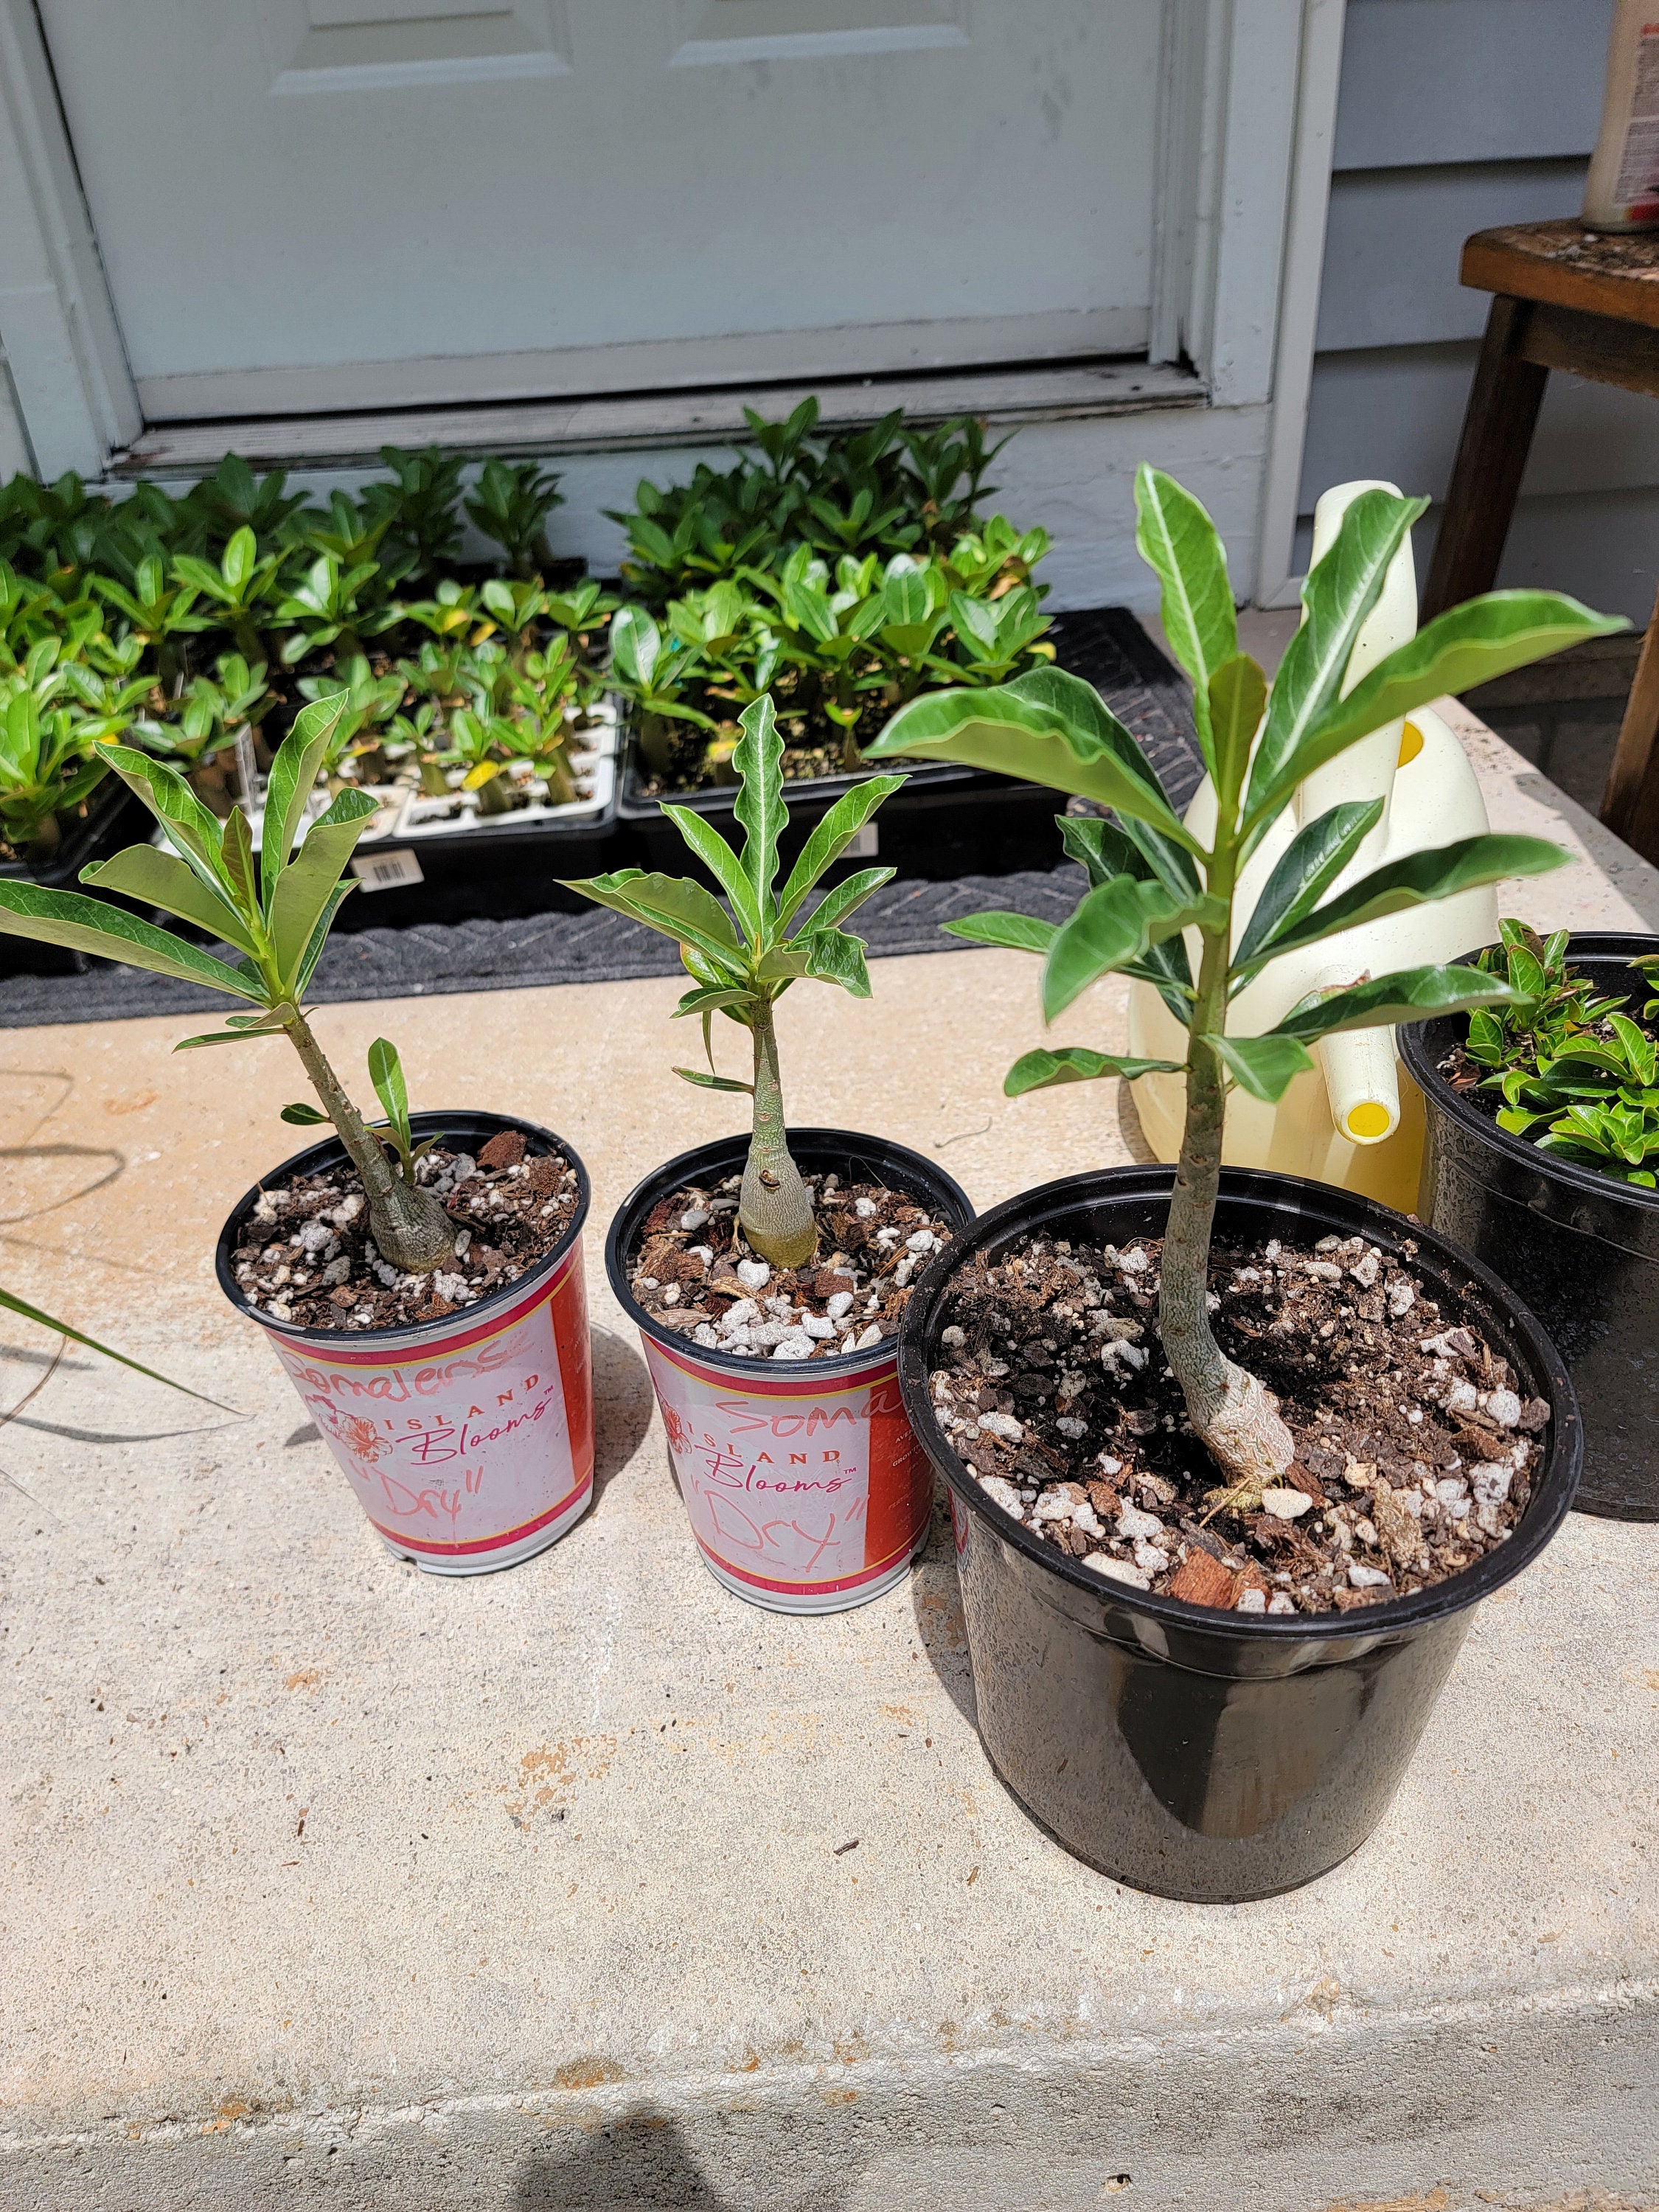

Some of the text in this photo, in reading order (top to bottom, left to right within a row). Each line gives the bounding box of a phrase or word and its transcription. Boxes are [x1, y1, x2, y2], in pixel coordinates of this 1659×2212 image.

[385, 1373, 540, 1431] ISLAND
[395, 1397, 552, 1466] Blooms
[687, 1420, 841, 1465] ISLAND
[694, 1444, 852, 1493] Blooms
